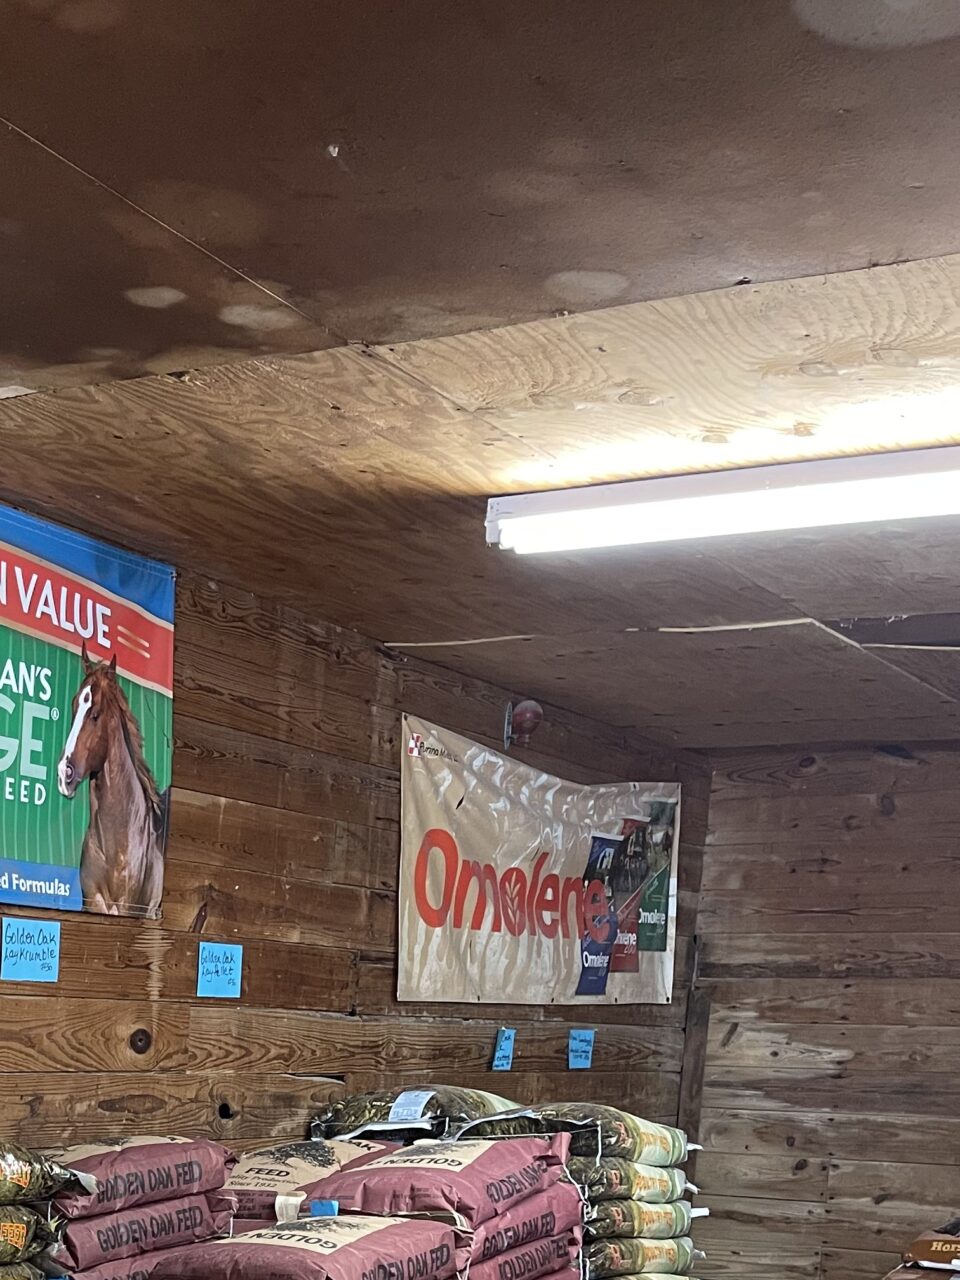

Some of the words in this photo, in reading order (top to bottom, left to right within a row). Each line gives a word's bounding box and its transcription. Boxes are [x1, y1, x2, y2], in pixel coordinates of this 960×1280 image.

[14, 566, 112, 649] VALUE
[12, 872, 70, 897] Formulas
[414, 829, 612, 943] Omolene
[5, 922, 35, 946] Golden
[37, 928, 57, 946] Oak
[96, 1170, 145, 1204] GOLDEN
[148, 1164, 174, 1191] OAK
[245, 1167, 290, 1177] FEED
[0, 1222, 27, 1250] FEED
[149, 1214, 175, 1239] OAK
[247, 1232, 338, 1249] GOLDEN
